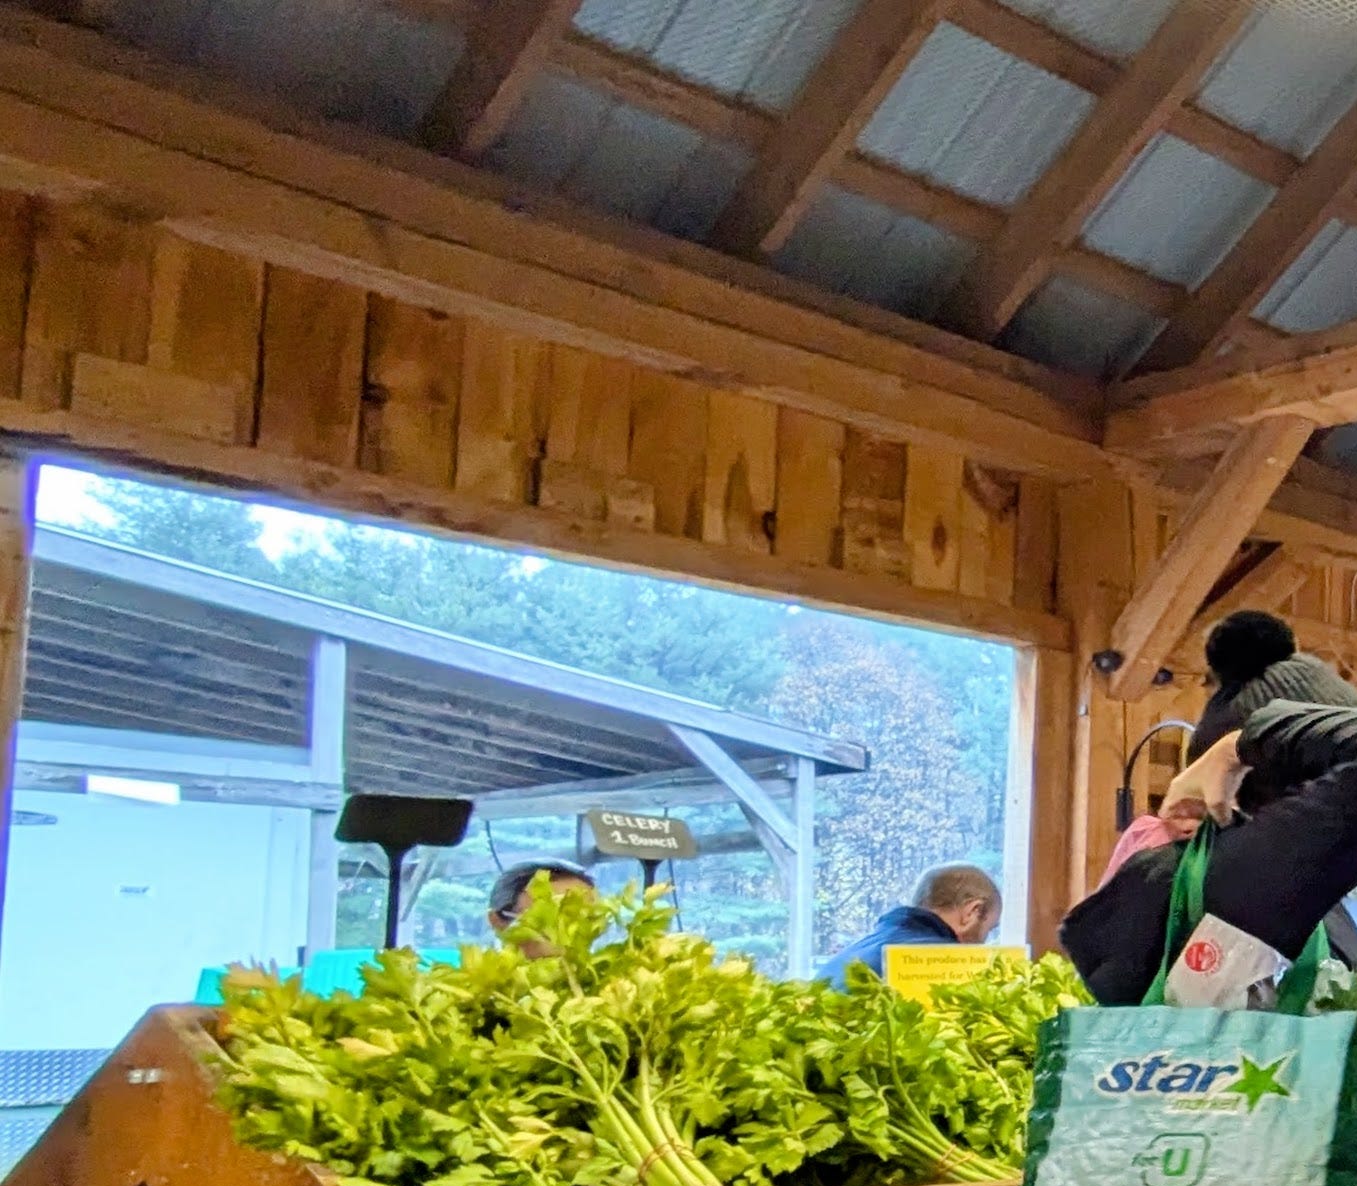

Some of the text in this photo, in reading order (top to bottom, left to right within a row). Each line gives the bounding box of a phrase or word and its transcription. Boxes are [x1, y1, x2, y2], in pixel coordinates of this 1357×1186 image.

[601, 812, 671, 834] CELERY
[902, 956, 988, 966] This produce has
[897, 972, 948, 981] harvested
[950, 972, 964, 981] for
[1097, 1055, 1240, 1094] star
[1162, 1149, 1191, 1177] U
